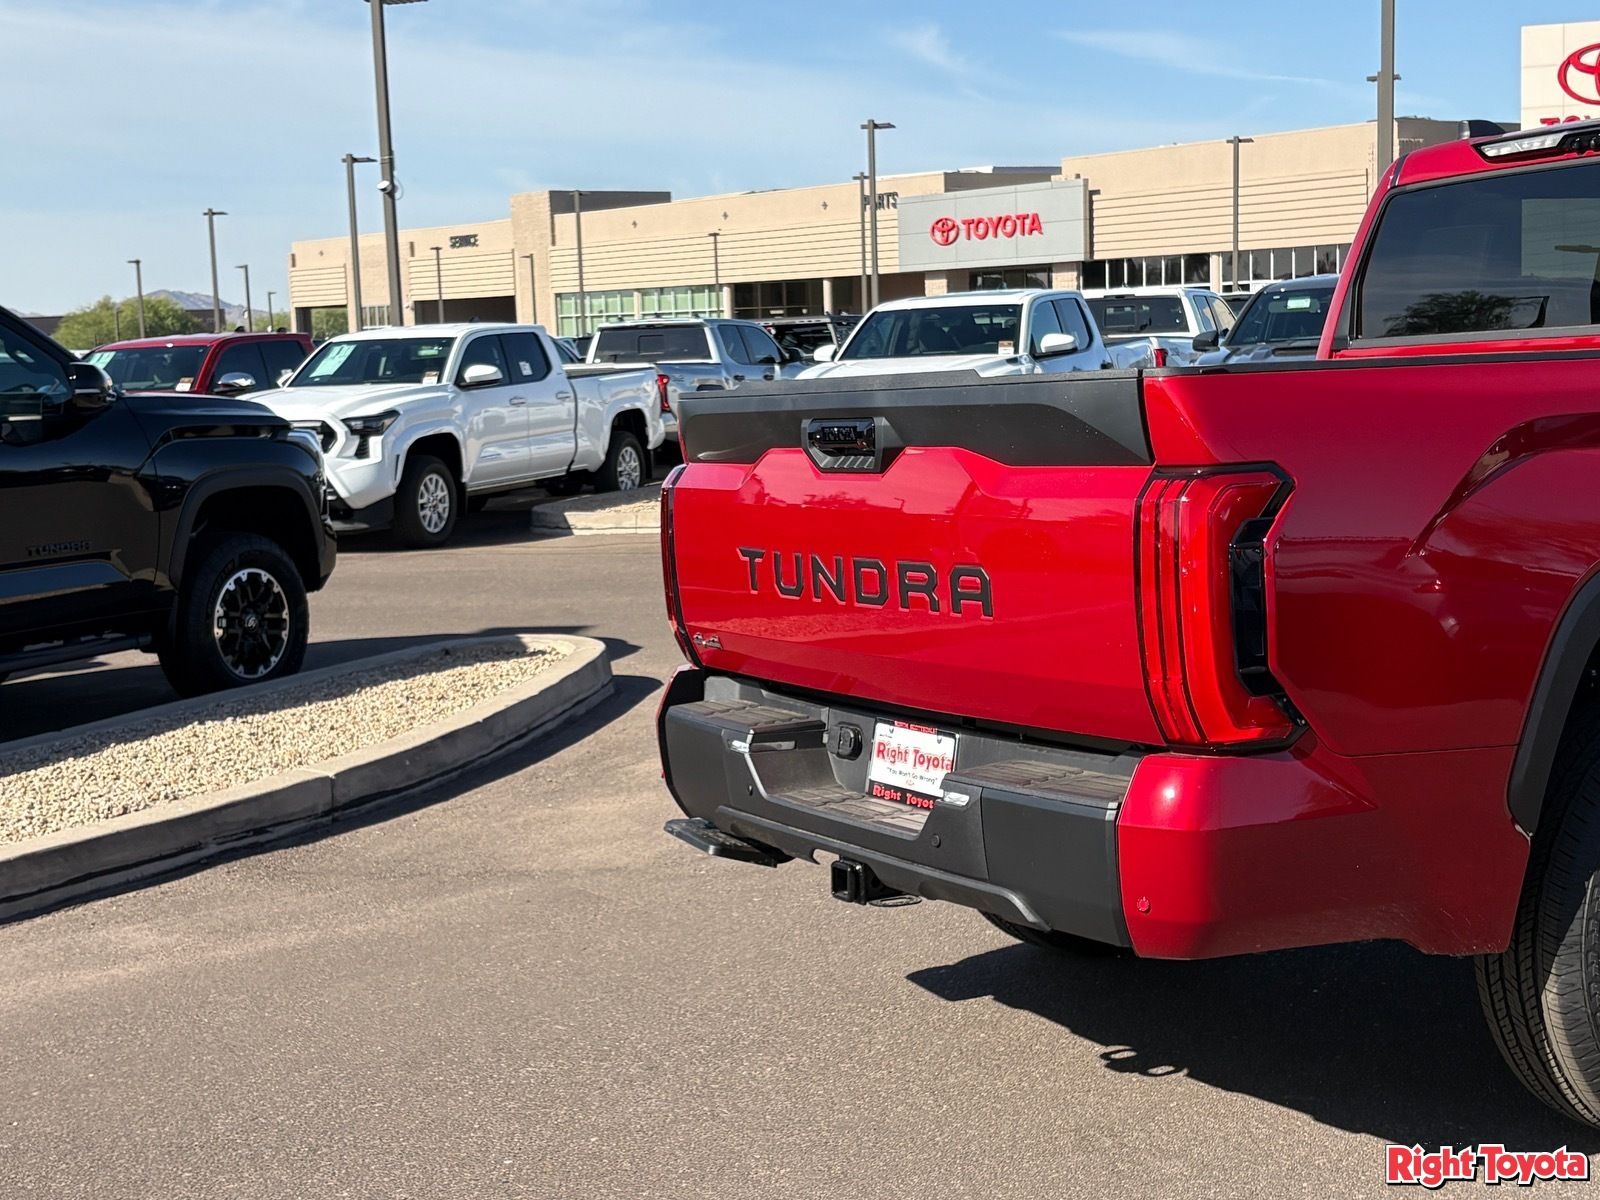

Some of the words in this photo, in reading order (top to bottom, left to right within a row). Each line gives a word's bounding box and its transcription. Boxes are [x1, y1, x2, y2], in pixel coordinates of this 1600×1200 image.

[863, 192, 898, 211] PRTS
[961, 213, 1043, 240] TOYOTA
[736, 546, 994, 620] TUNDRA
[876, 741, 909, 764] Right
[913, 748, 952, 771] Toyota
[872, 784, 902, 801] Right
[906, 792, 934, 809] Toyot
